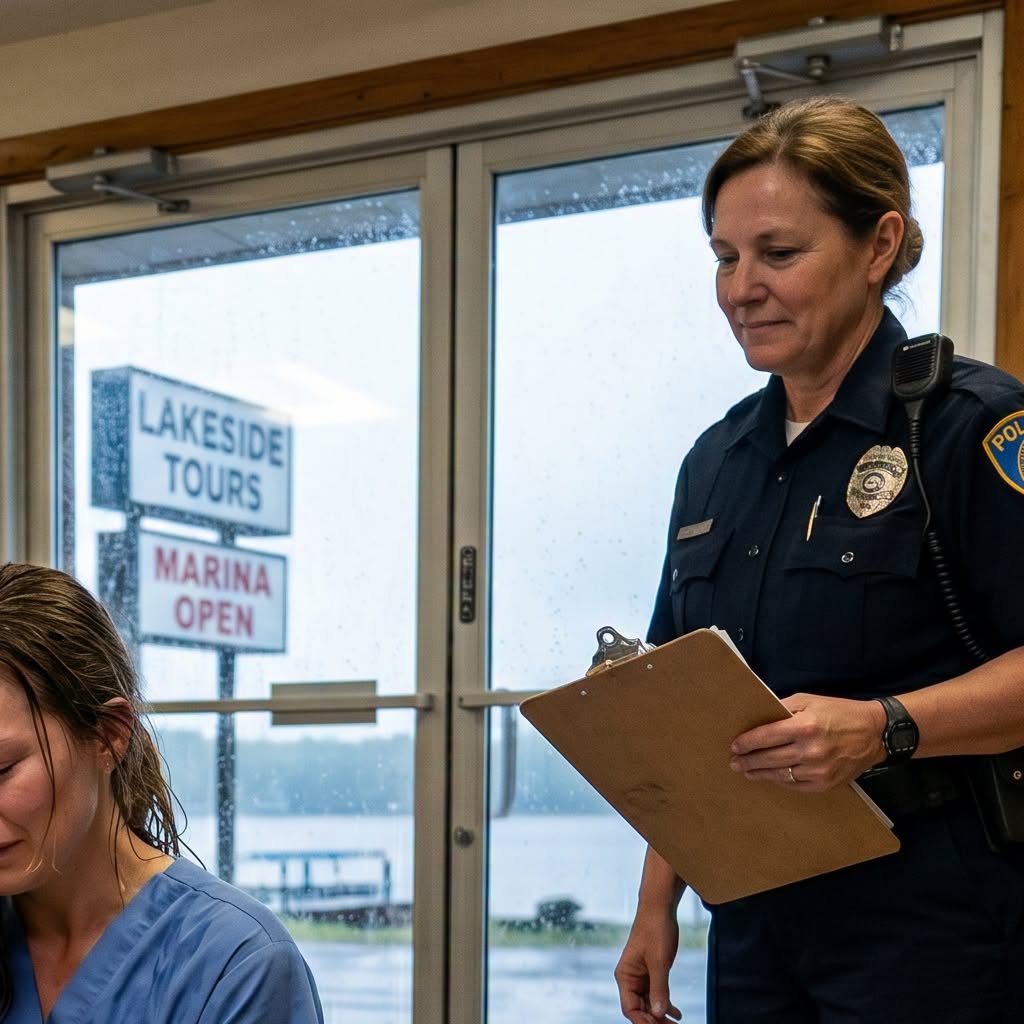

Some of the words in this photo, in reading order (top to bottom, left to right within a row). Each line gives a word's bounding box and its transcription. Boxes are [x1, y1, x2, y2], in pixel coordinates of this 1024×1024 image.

[139, 391, 284, 467] LAKESIDE
[164, 453, 261, 511] TOURS
[154, 546, 271, 597] MARINA
[174, 596, 254, 637] OPEN
